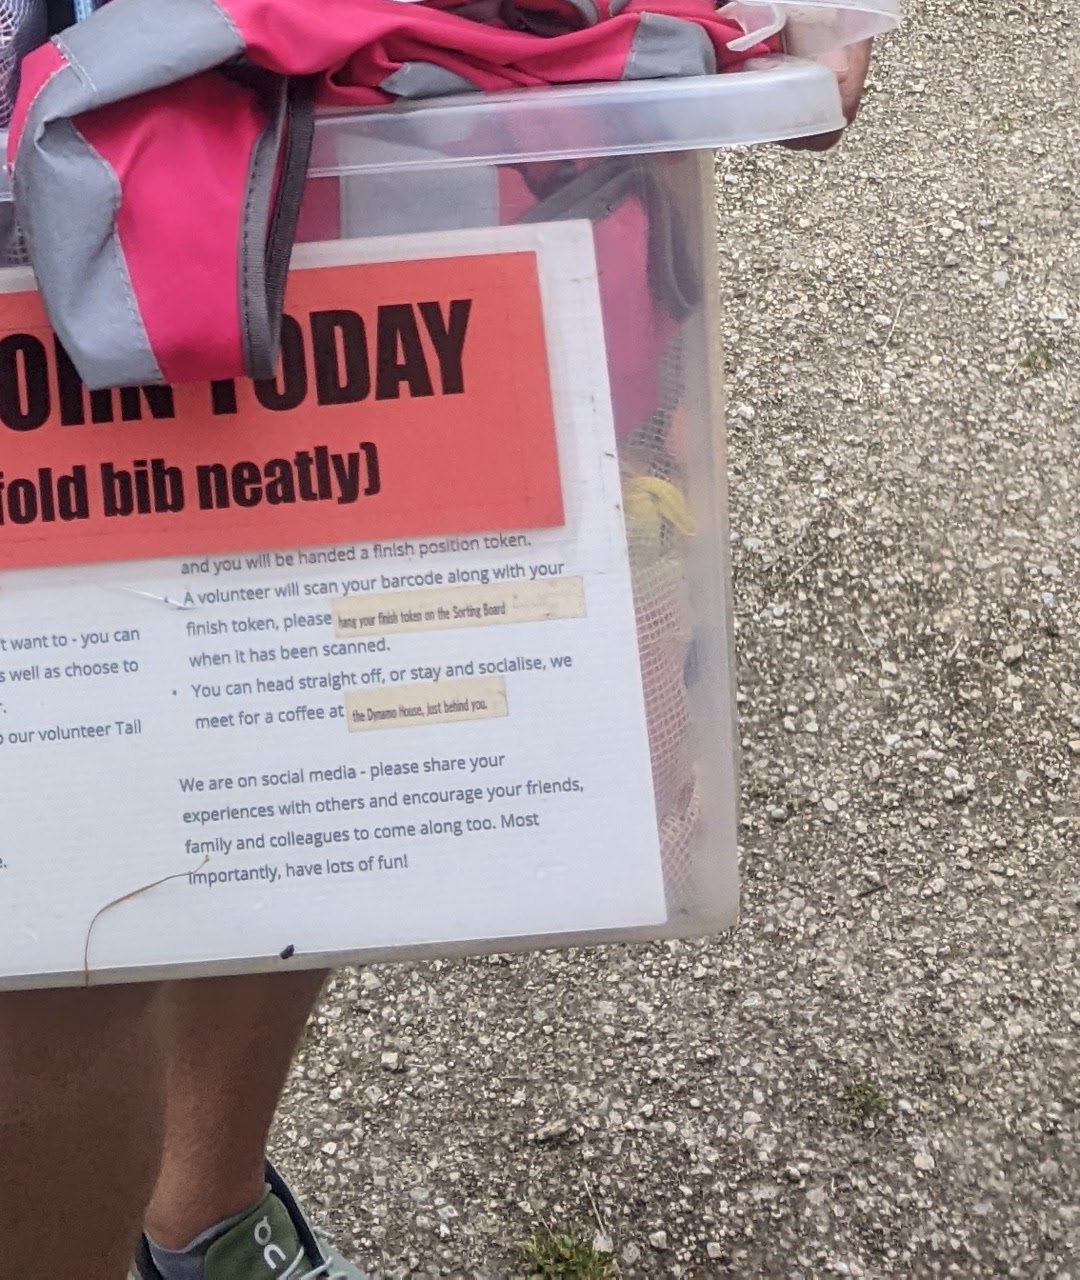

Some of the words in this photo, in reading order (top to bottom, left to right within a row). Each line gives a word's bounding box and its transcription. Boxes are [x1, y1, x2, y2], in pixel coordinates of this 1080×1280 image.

[101, 458, 185, 518] bib
[197, 441, 382, 510] neatly)
[180, 559, 210, 576] and
[213, 559, 242, 577] you
[245, 553, 271, 570] will
[274, 553, 294, 567] be
[298, 546, 356, 565] handed
[360, 548, 370, 560] a
[372, 542, 415, 559] finish
[418, 538, 480, 559] position
[483, 533, 532, 550] token.
[183, 591, 196, 607] A
[197, 587, 271, 605] volunteer
[273, 581, 300, 598] will
[303, 581, 339, 596] scan
[341, 578, 378, 598] your
[380, 569, 444, 590] barcode
[447, 568, 490, 585] along
[491, 562, 526, 580] with
[528, 563, 565, 581] your
[185, 619, 228, 637] finish
[231, 616, 280, 633] token,
[283, 612, 333, 633] please
[359, 617, 376, 629] your
[378, 611, 398, 625] finish
[401, 610, 422, 623] token
[424, 611, 435, 621] on
[437, 608, 450, 620] the
[453, 605, 481, 619] Sorting
[483, 602, 506, 616] Board
[9, 635, 50, 651] want
[51, 634, 68, 648] to
[80, 631, 110, 650] you
[113, 629, 140, 643] can
[188, 651, 232, 668] when
[235, 649, 247, 664] it
[248, 647, 277, 663] has
[279, 644, 319, 661] been
[322, 636, 391, 657] scanned.
[8, 665, 40, 682] well
[44, 666, 61, 680] as
[64, 661, 119, 678] choose
[122, 659, 139, 673] to
[190, 683, 221, 699] You
[225, 682, 253, 696] can
[256, 675, 295, 694] head
[298, 670, 358, 691] straight
[360, 667, 386, 685] off,
[389, 669, 407, 682] or
[409, 666, 442, 683] stay
[445, 660, 475, 678] and
[478, 656, 547, 675] socialise,
[549, 655, 573, 669] we
[7, 730, 36, 744] our
[37, 724, 112, 742] volunteer
[114, 718, 142, 736] Tail
[195, 714, 236, 729] meet
[237, 710, 261, 726] for
[264, 711, 274, 724] a
[277, 704, 325, 723] coffee
[328, 704, 345, 719] at
[352, 710, 365, 722] the
[427, 702, 441, 716] just
[444, 699, 469, 713] behind
[178, 777, 205, 793] We
[208, 777, 234, 791] are
[237, 775, 258, 789] on
[261, 768, 305, 787] social
[308, 764, 357, 783] media
[369, 761, 420, 782] please
[422, 756, 467, 773] share
[468, 754, 506, 774] your
[182, 804, 275, 826] experiences
[277, 799, 312, 816] with
[315, 796, 366, 813] others
[368, 791, 399, 809] and
[401, 787, 484, 806] encourage
[486, 784, 523, 803] your
[525, 776, 584, 796] friends,
[184, 836, 233, 856] family
[236, 833, 266, 851] and
[269, 829, 351, 849] colleagues
[353, 827, 370, 842] to
[373, 824, 416, 840] come
[419, 819, 464, 837] along
[465, 818, 497, 832] too.
[500, 812, 540, 829] Most
[285, 862, 323, 878] have
[326, 858, 355, 875] lots
[357, 855, 375, 872] of
[377, 853, 409, 871] fun!
